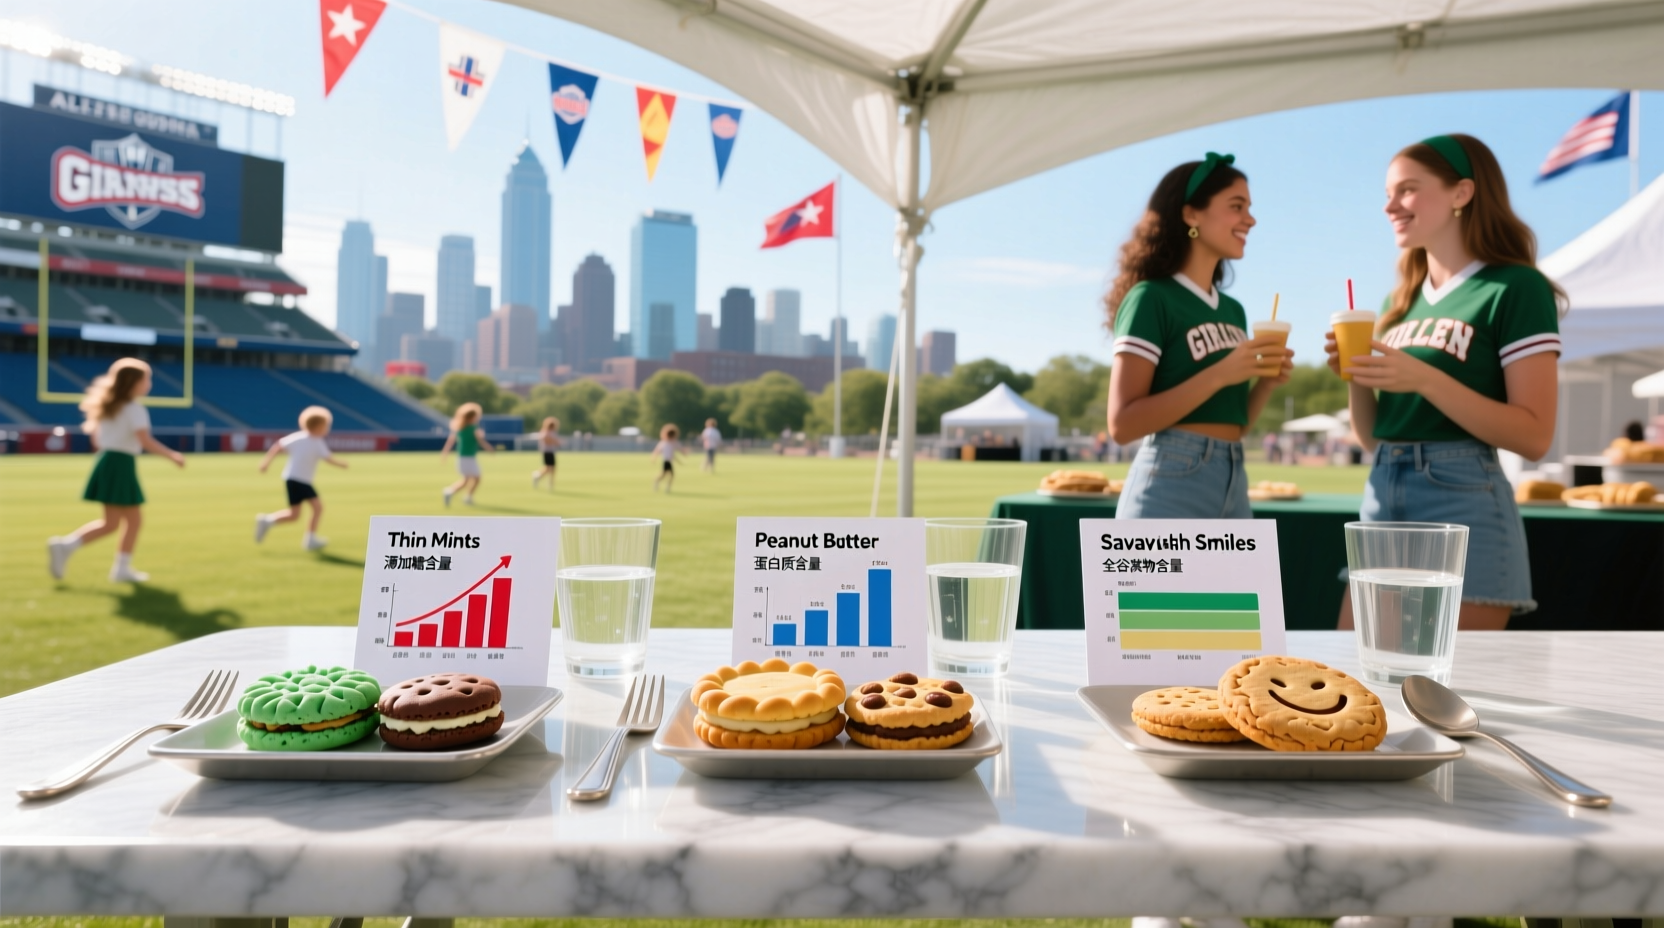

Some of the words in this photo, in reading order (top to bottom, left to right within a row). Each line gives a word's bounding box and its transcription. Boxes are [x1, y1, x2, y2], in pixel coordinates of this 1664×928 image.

[388, 531, 427, 548] Thin
[431, 531, 481, 549] Mints
[755, 532, 819, 549] Peanut
[1195, 533, 1257, 551] Smiles
